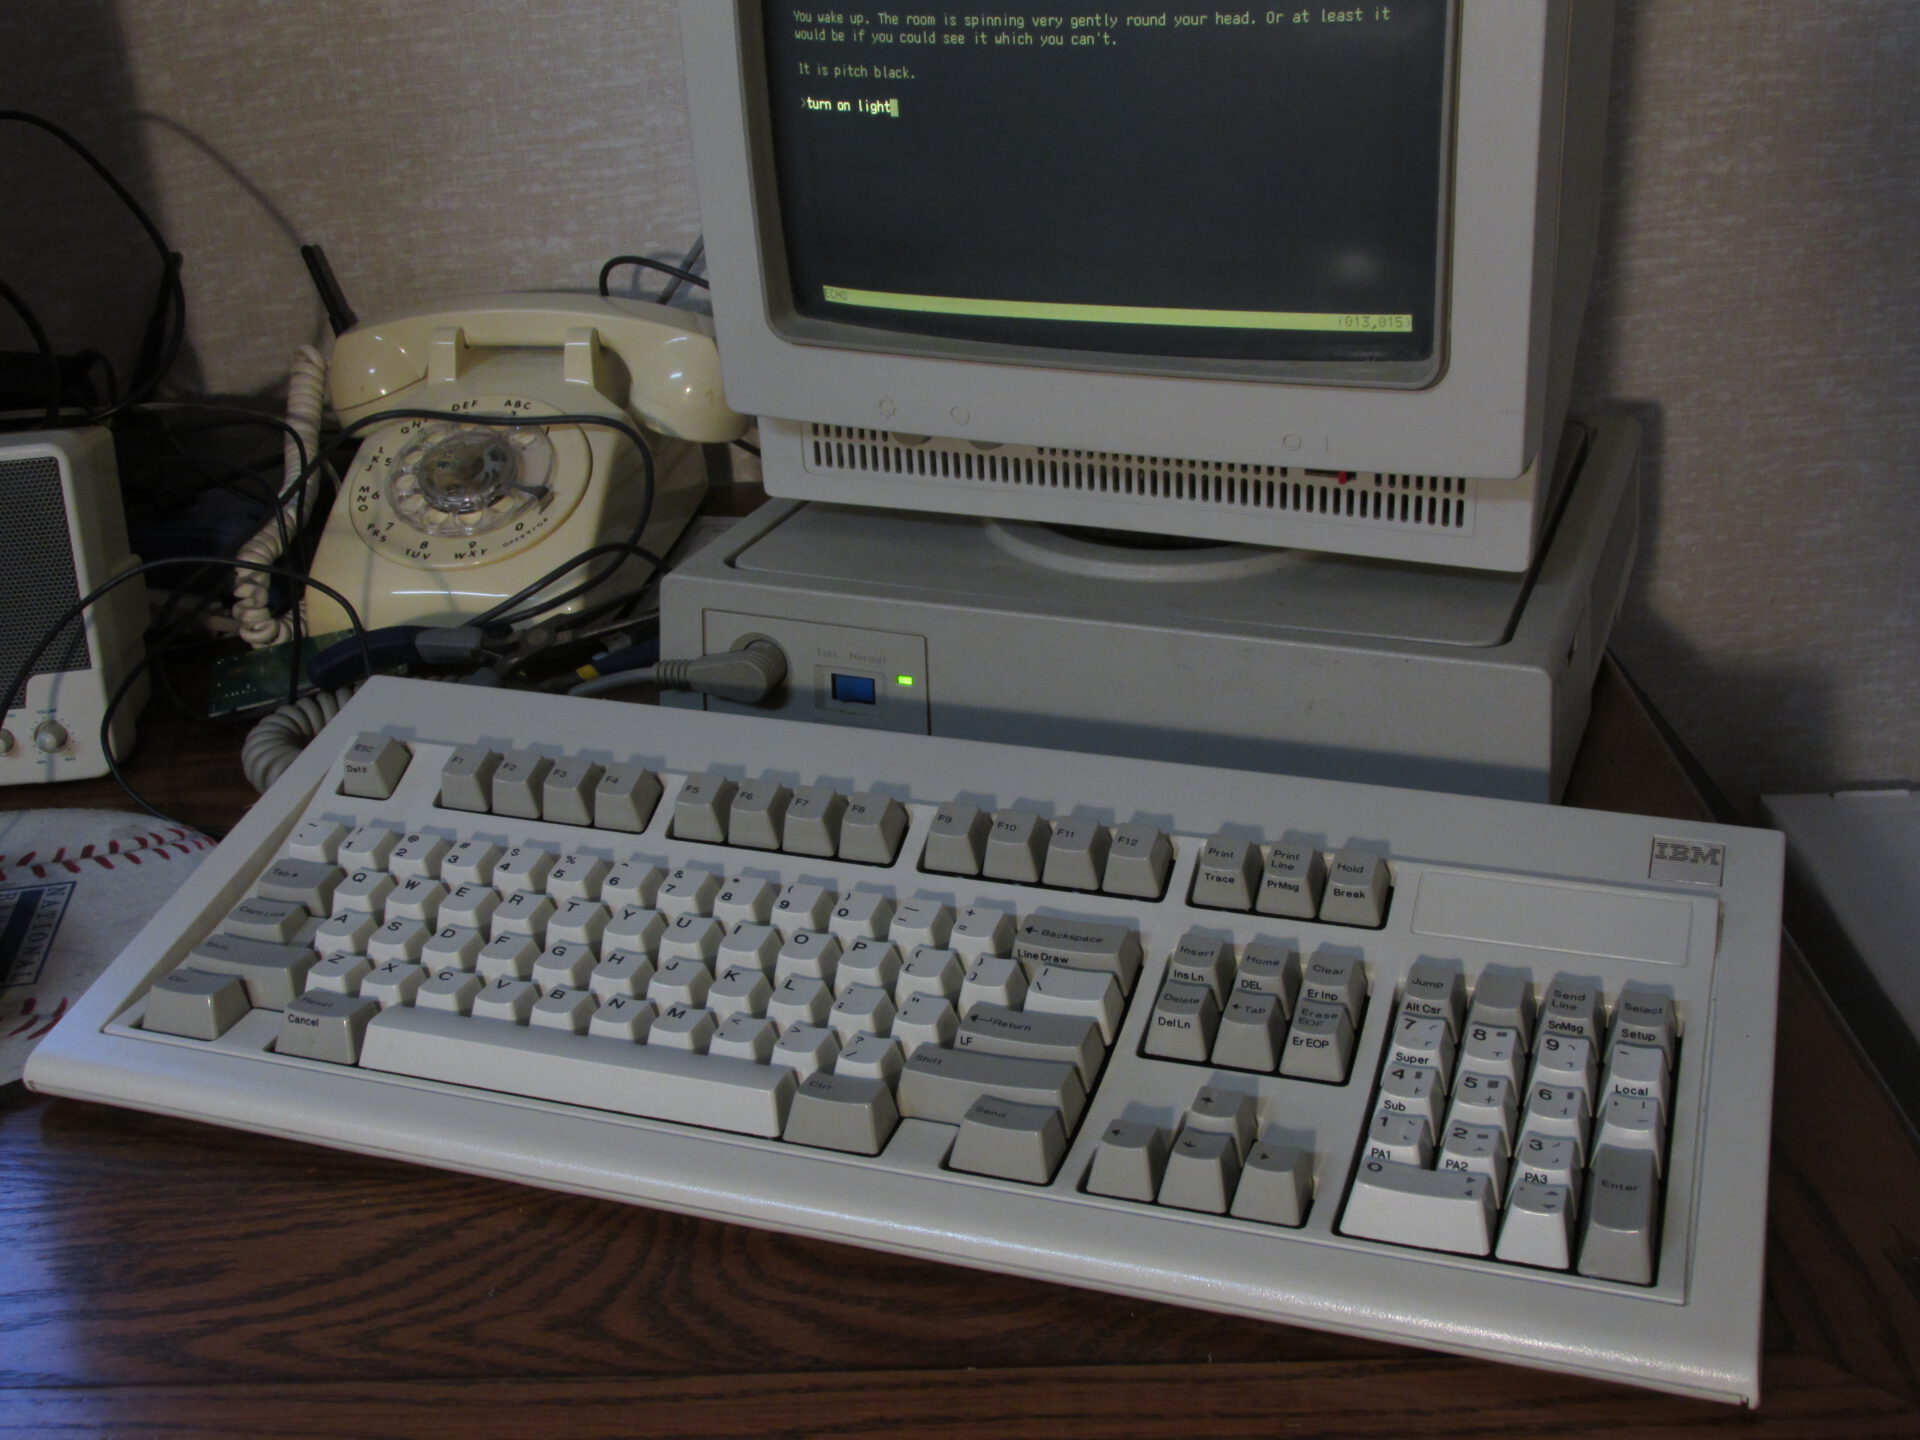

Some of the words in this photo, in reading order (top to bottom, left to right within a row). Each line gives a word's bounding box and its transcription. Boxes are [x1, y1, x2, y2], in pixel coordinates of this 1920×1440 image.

[794, 10, 812, 23] You
[817, 11, 843, 24] wake
[850, 14, 870, 26] up.
[878, 12, 899, 25] The
[906, 15, 936, 26] room
[944, 13, 957, 26] is
[964, 13, 1025, 28] spinning
[1032, 15, 1063, 28] very
[1070, 13, 1118, 28] gently
[1127, 13, 1166, 26] round
[1174, 15, 1207, 28] your
[1215, 12, 1256, 25] head.
[1266, 11, 1285, 24] Or
[1292, 9, 1310, 23] at
[1322, 8, 1363, 22] least
[1375, 6, 1390, 21] it
[795, 29, 826, 41] would
[831, 30, 845, 42] be
[853, 29, 866, 42] if
[872, 32, 893, 45] you
[900, 30, 936, 43] could
[943, 33, 965, 45] see
[975, 32, 988, 45] it
[995, 32, 1032, 45] which
[1041, 35, 1063, 47] you
[1071, 33, 1117, 46] can't.
[799, 63, 810, 75] It
[817, 64, 828, 76] is
[834, 64, 868, 78] pitch
[874, 66, 916, 80] black.
[837, 100, 851, 112] on
[859, 99, 891, 115] light
[452, 399, 478, 412] DEF
[504, 399, 532, 410] ABC
[420, 541, 428, 549] 8
[404, 549, 431, 561] TUV
[454, 548, 488, 560] WXY
[452, 756, 463, 764] F1
[503, 762, 517, 771] F2
[553, 769, 567, 778] F3
[605, 775, 619, 784] F4
[685, 784, 699, 794] F5
[740, 791, 753, 800] F6
[795, 798, 810, 807] F7
[852, 805, 865, 814] F8
[937, 814, 952, 824] F9
[997, 821, 1017, 832] F10
[1057, 828, 1075, 838] F11
[1117, 836, 1138, 846] F12
[396, 848, 408, 857] 2
[1208, 847, 1234, 859] Print
[1274, 850, 1299, 861] Print
[1655, 842, 1721, 866] IBM
[448, 855, 459, 864] 3
[500, 862, 511, 871] 4
[1271, 860, 1294, 871] Line
[1337, 863, 1364, 873] Hold
[352, 872, 367, 882] Q
[553, 869, 565, 878] 5
[1205, 872, 1235, 884] Trace
[404, 879, 421, 890] W
[609, 877, 620, 886] 6
[1267, 880, 1299, 892] PrMsg
[455, 887, 470, 897] E
[665, 884, 677, 893] 7
[1333, 888, 1365, 899] Break
[508, 894, 524, 905] R
[721, 892, 733, 901] 8
[567, 901, 580, 912] T
[779, 900, 790, 909] 9
[334, 914, 348, 923] A
[622, 909, 637, 920] Y
[387, 921, 402, 931] S
[676, 917, 692, 928] U
[11, 886, 67, 981] NATIONAL
[440, 928, 456, 938] D
[733, 925, 742, 935] I
[494, 935, 510, 945] F
[793, 934, 809, 945] O
[1040, 929, 1103, 944] Backspace
[551, 946, 567, 957] G
[852, 941, 868, 951] P
[1180, 945, 1215, 958] Insert
[327, 954, 345, 964] Z
[607, 953, 625, 965] H
[1017, 949, 1039, 961] Line
[1040, 952, 1068, 964] Draw
[1246, 955, 1280, 967] Home
[381, 963, 398, 973] X
[665, 962, 680, 971] J
[1312, 964, 1344, 975] Clear
[438, 971, 454, 981] C
[723, 970, 741, 982] K
[1173, 970, 1189, 980] Ins
[1191, 972, 1204, 982] Ln
[497, 980, 512, 989] V
[784, 979, 795, 991] L
[1241, 979, 1262, 991] DEL
[1411, 978, 1444, 989] Jump
[550, 989, 566, 999] B
[1163, 992, 1199, 1004] Delete
[1307, 989, 1319, 999] Er
[1321, 990, 1338, 1001] Inp
[1553, 990, 1586, 1001] Send
[608, 998, 626, 1009] N
[1405, 1002, 1421, 1012] Alt
[1422, 1004, 1441, 1014] Csr
[1551, 1000, 1578, 1011] Line
[1623, 1002, 1664, 1015] Select
[667, 1007, 687, 1019] M
[1244, 1006, 1266, 1014] Tab
[1301, 1007, 1338, 1019] Erase
[288, 1014, 319, 1027] Cancel
[992, 1018, 1032, 1032] Return
[1158, 1016, 1176, 1028] Del
[1177, 1018, 1191, 1029] Ln
[1404, 1019, 1417, 1031] 7
[1548, 1020, 1584, 1035] SnMsg
[1473, 1028, 1486, 1041] 8
[1620, 1029, 1656, 1042] Setup
[960, 1036, 973, 1046] LF
[1292, 1036, 1304, 1046] Er
[1306, 1038, 1329, 1049] EOP
[1546, 1039, 1560, 1051] 9
[915, 1054, 943, 1065] Shift
[1395, 1052, 1430, 1065] Super
[1391, 1069, 1405, 1079] 4
[1464, 1077, 1478, 1088] 5
[1539, 1088, 1553, 1101] 6
[1615, 1084, 1648, 1096] Local
[1384, 1099, 1406, 1112] Sub
[974, 1105, 1006, 1119] Send
[1379, 1116, 1388, 1127] 1
[1452, 1128, 1468, 1139] 2
[1529, 1139, 1543, 1151] 3
[1371, 1147, 1392, 1160] PA1
[1445, 1159, 1468, 1172] PA2
[1524, 1172, 1548, 1185] PA3
[1601, 1179, 1639, 1192] Enter
